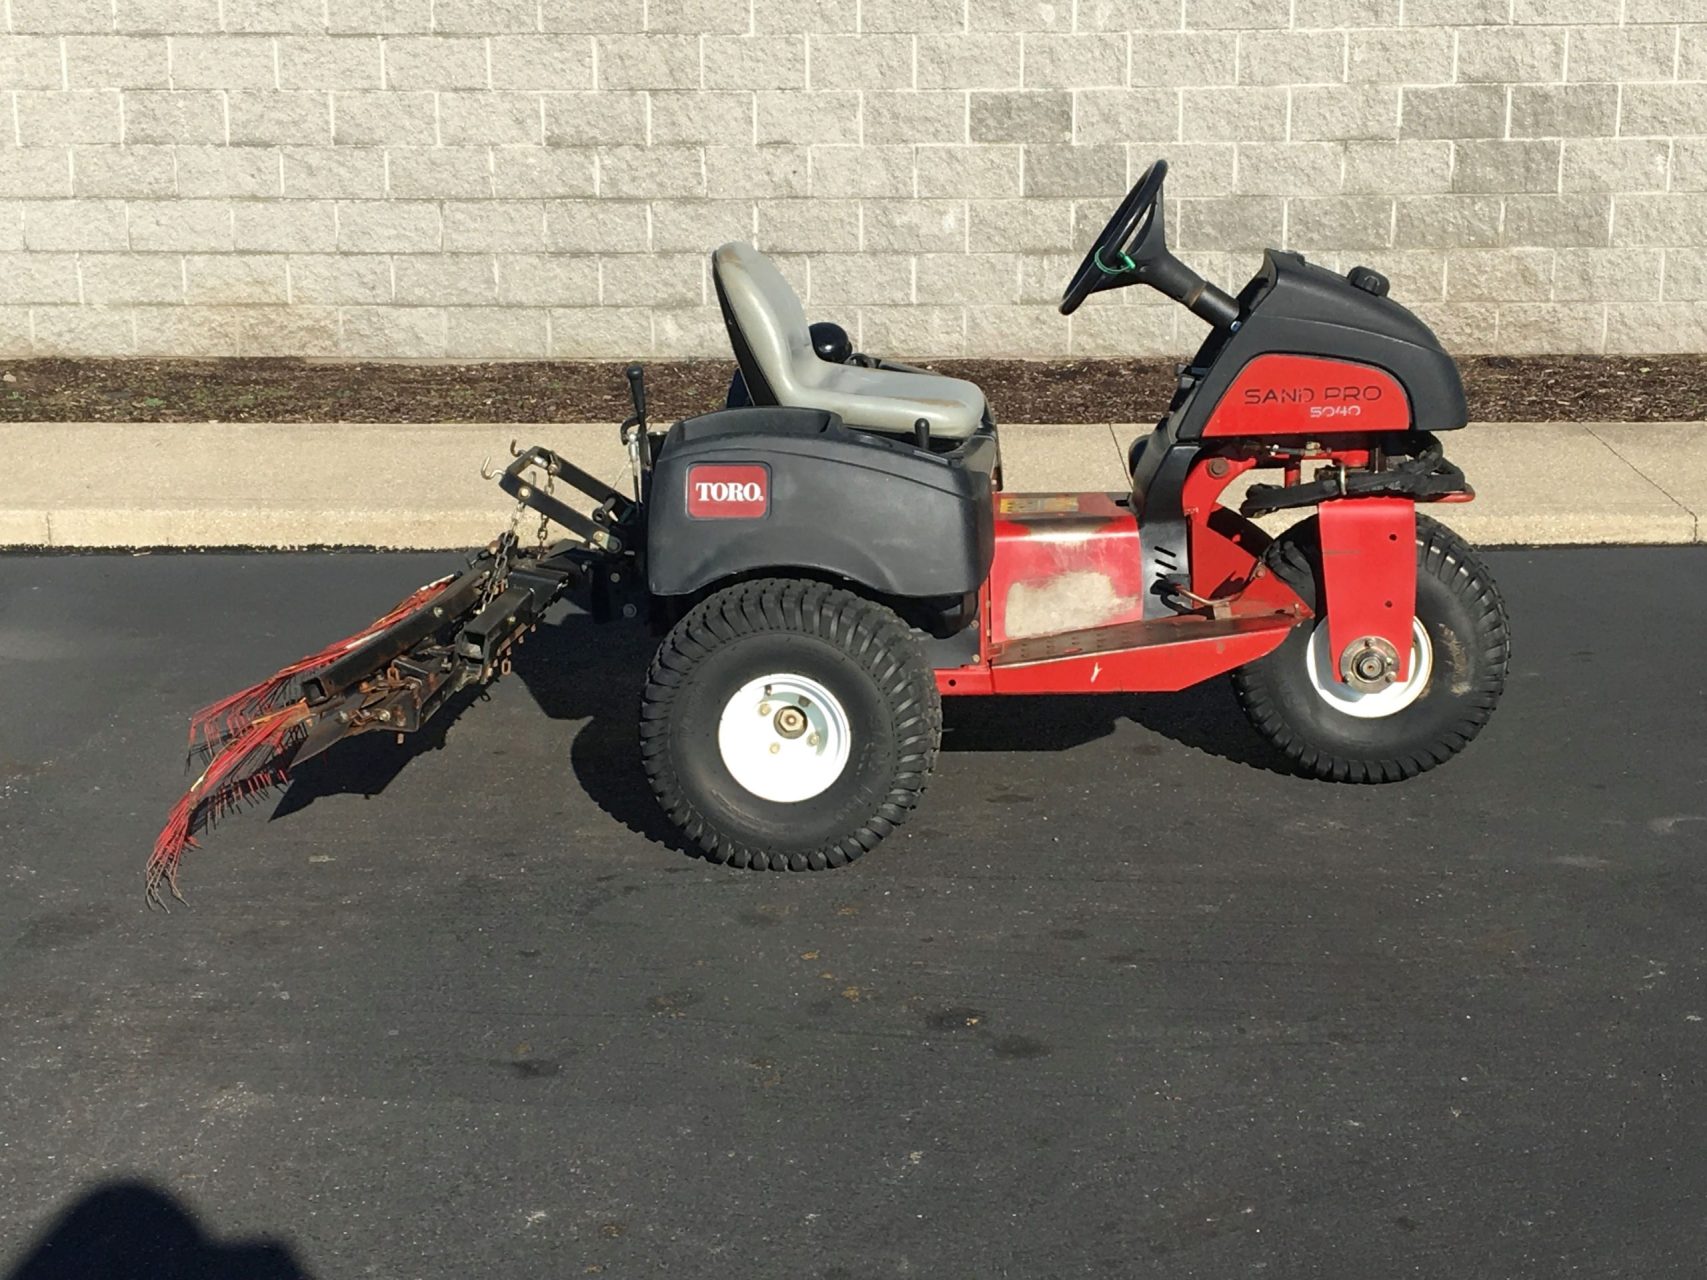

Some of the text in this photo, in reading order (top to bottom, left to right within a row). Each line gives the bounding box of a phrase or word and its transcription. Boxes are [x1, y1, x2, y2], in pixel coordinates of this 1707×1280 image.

[1244, 386, 1381, 404] SAND PRO
[1310, 405, 1361, 418] 5040
